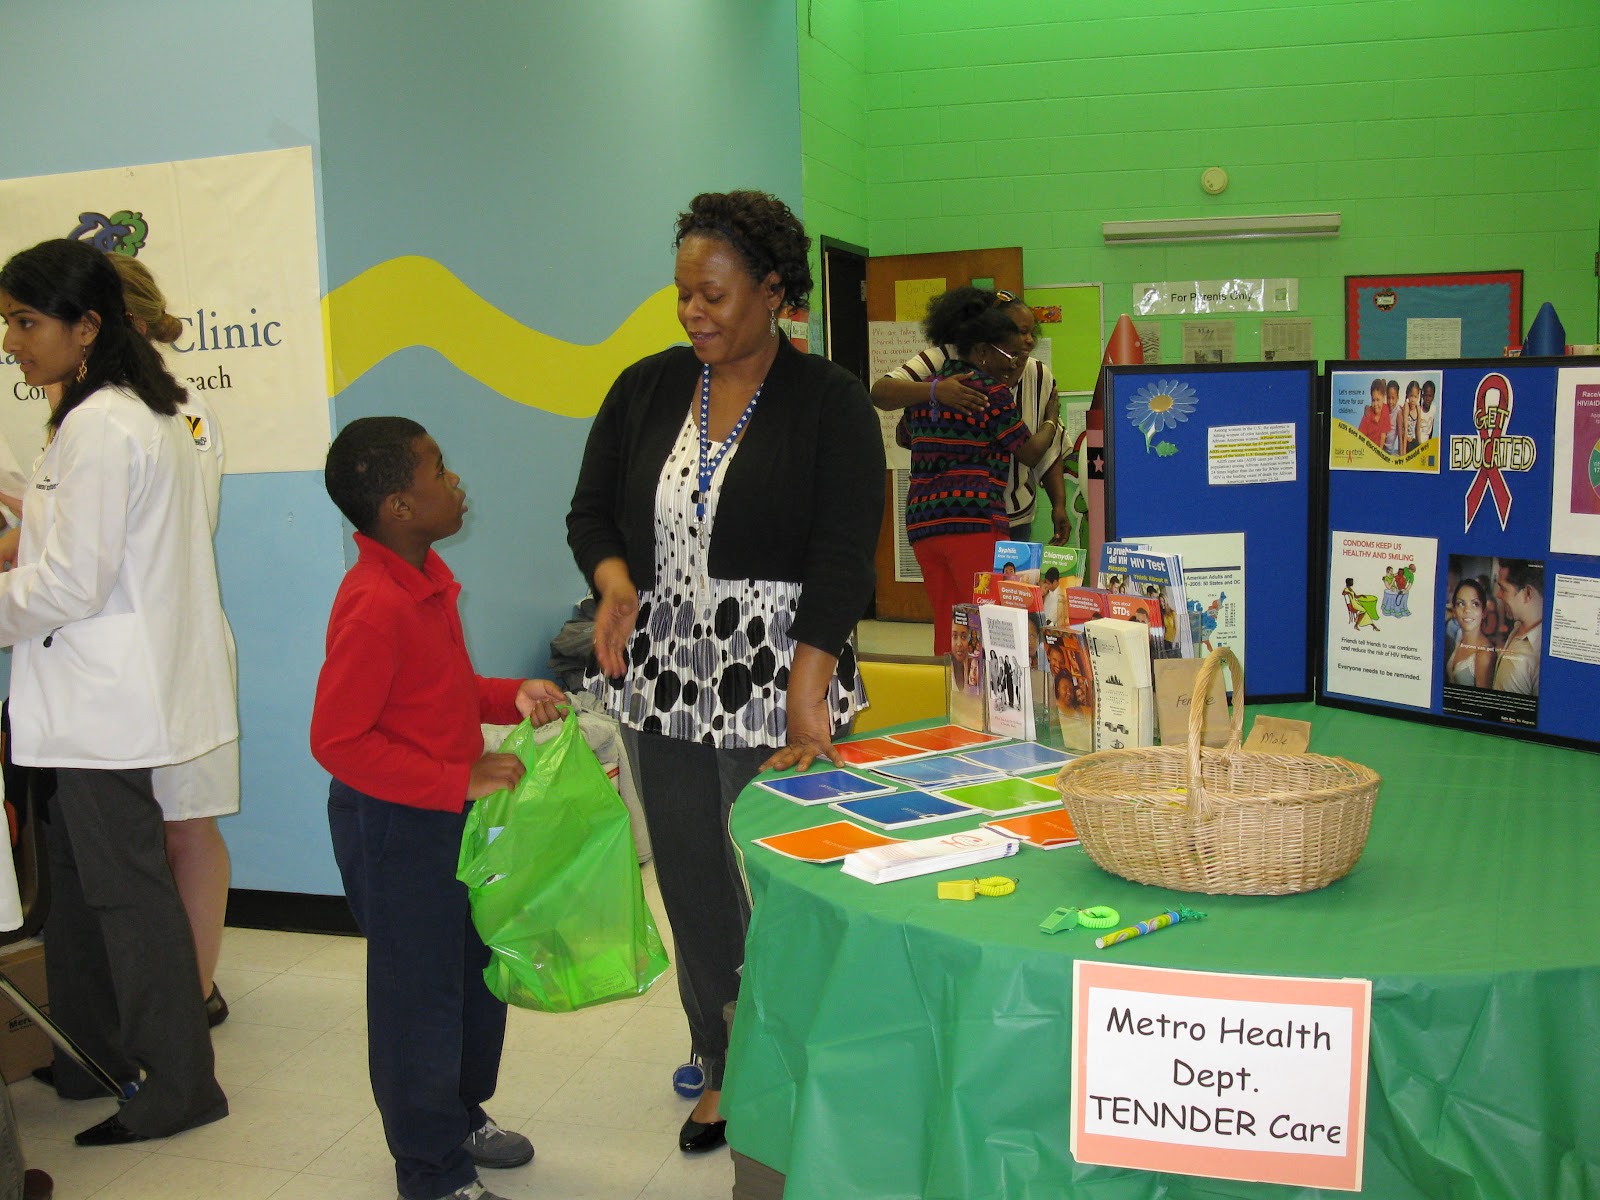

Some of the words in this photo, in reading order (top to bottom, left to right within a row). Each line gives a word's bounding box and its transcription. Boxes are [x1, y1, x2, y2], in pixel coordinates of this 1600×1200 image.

[1171, 294, 1187, 302] For
[1190, 292, 1227, 301] Prents
[170, 308, 282, 353] Clinic
[1474, 406, 1510, 430] GET
[1452, 437, 1535, 470] EDUCATED
[1343, 539, 1374, 548] CONDOMS
[1044, 552, 1073, 561] Chlamydia
[1113, 547, 1132, 556] prueb
[1388, 553, 1414, 561] SMILING
[1130, 557, 1144, 568] HIV
[1146, 560, 1166, 572] Test
[1113, 607, 1130, 616] STDs
[1338, 663, 1361, 672] Everyone
[1176, 694, 1215, 708] Femle
[1260, 732, 1288, 745] Male
[1106, 1007, 1206, 1041] Metro
[1219, 1016, 1331, 1051] Health
[1173, 1058, 1259, 1097] Dept.
[1089, 1095, 1256, 1137] TENNDER
[1269, 1114, 1341, 1144] Care
